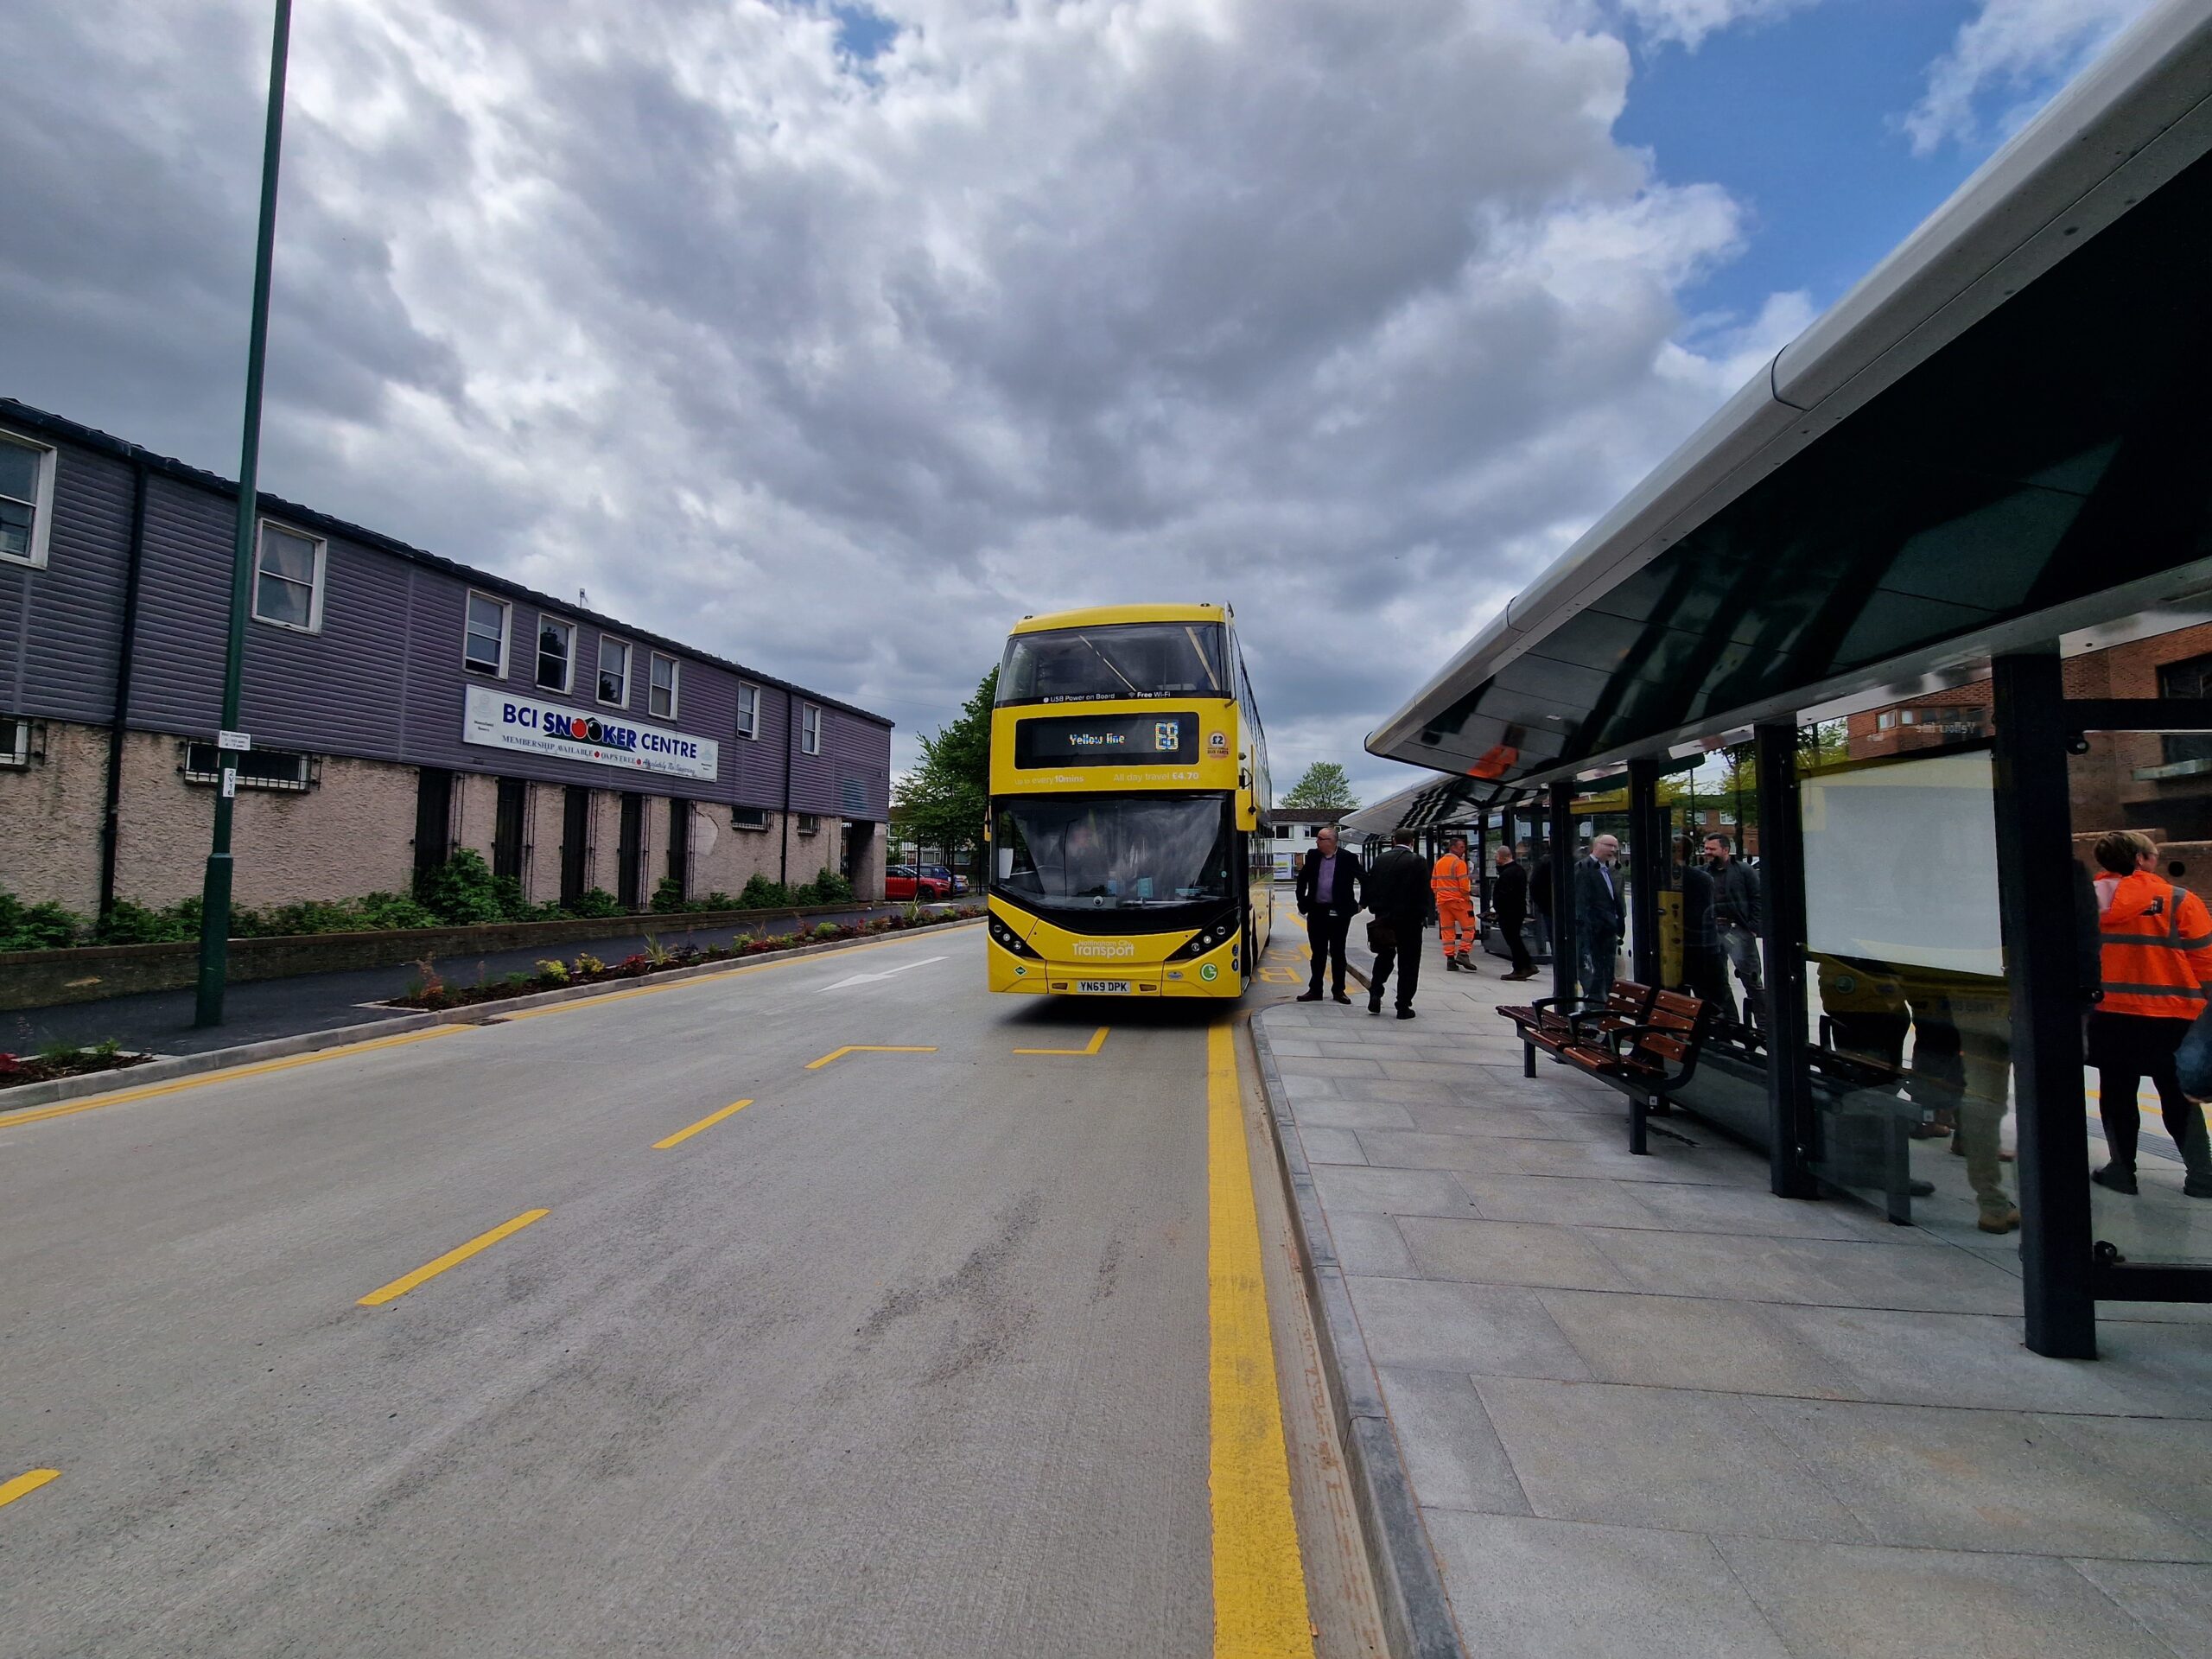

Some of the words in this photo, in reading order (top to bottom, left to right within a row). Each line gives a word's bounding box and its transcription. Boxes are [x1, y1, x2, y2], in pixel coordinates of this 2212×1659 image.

[503, 702, 537, 728] BCI
[543, 711, 637, 749] SNOOKER
[641, 733, 697, 760] CENTRE
[502, 734, 555, 749] MEMBERSHIP
[556, 745, 594, 757] AVAILABLE
[1068, 734, 1103, 746] Yellow
[1105, 733, 1125, 744] line
[1212, 735, 1224, 745] £2
[1032, 776, 1053, 786] every
[1054, 774, 1084, 783] 10mins
[1113, 773, 1125, 782] All
[1126, 773, 1142, 783] day
[1145, 772, 1170, 781] travel
[1172, 771, 1200, 781] £4.70
[1072, 943, 1135, 958] Transport
[1080, 982, 1106, 992] YN69
[1108, 982, 1127, 992] DPK
